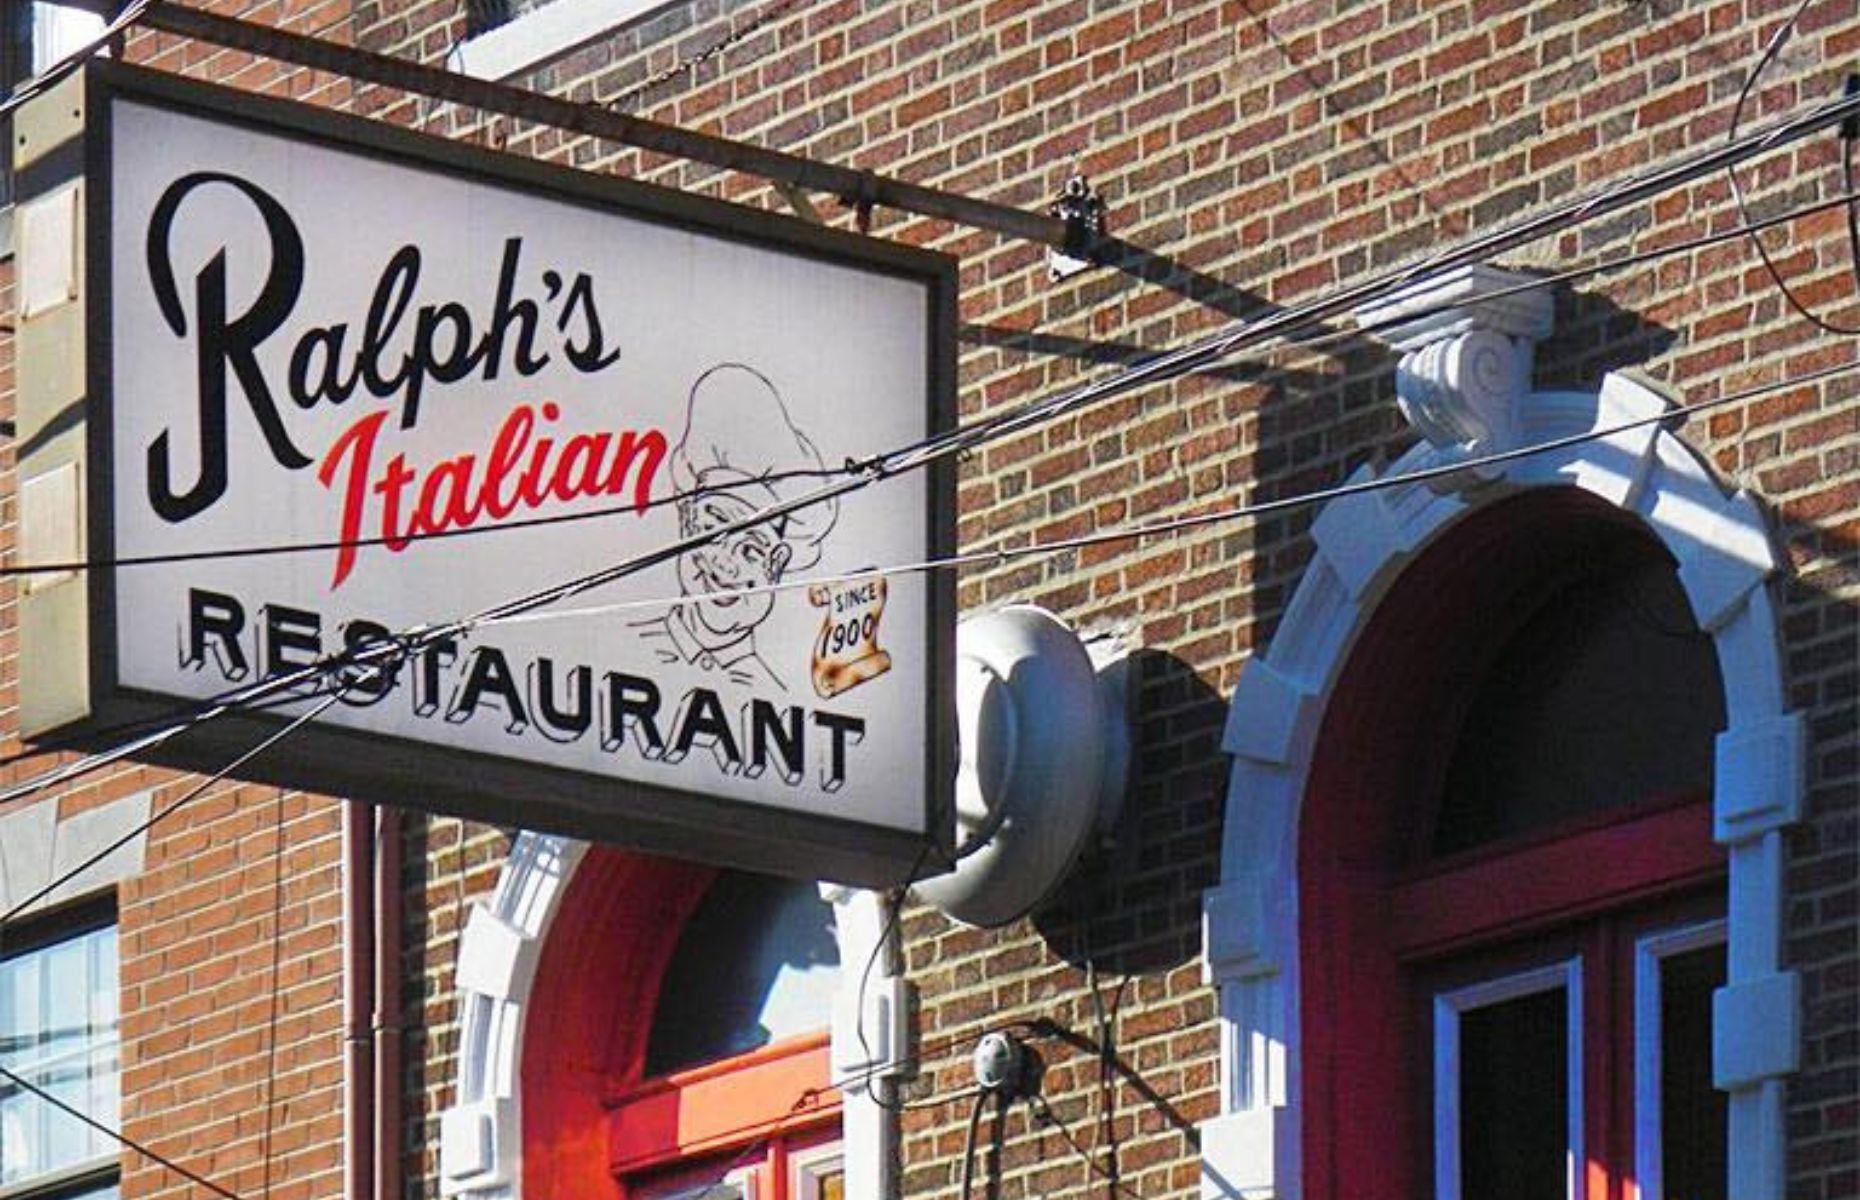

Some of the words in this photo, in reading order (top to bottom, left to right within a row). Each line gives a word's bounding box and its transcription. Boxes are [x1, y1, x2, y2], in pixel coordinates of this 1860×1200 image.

[146, 172, 620, 522] Ralph's
[318, 402, 667, 591] Italian
[178, 588, 865, 793] RESTAURANT
[821, 613, 873, 658] 1900
[835, 583, 876, 612] SINCE
